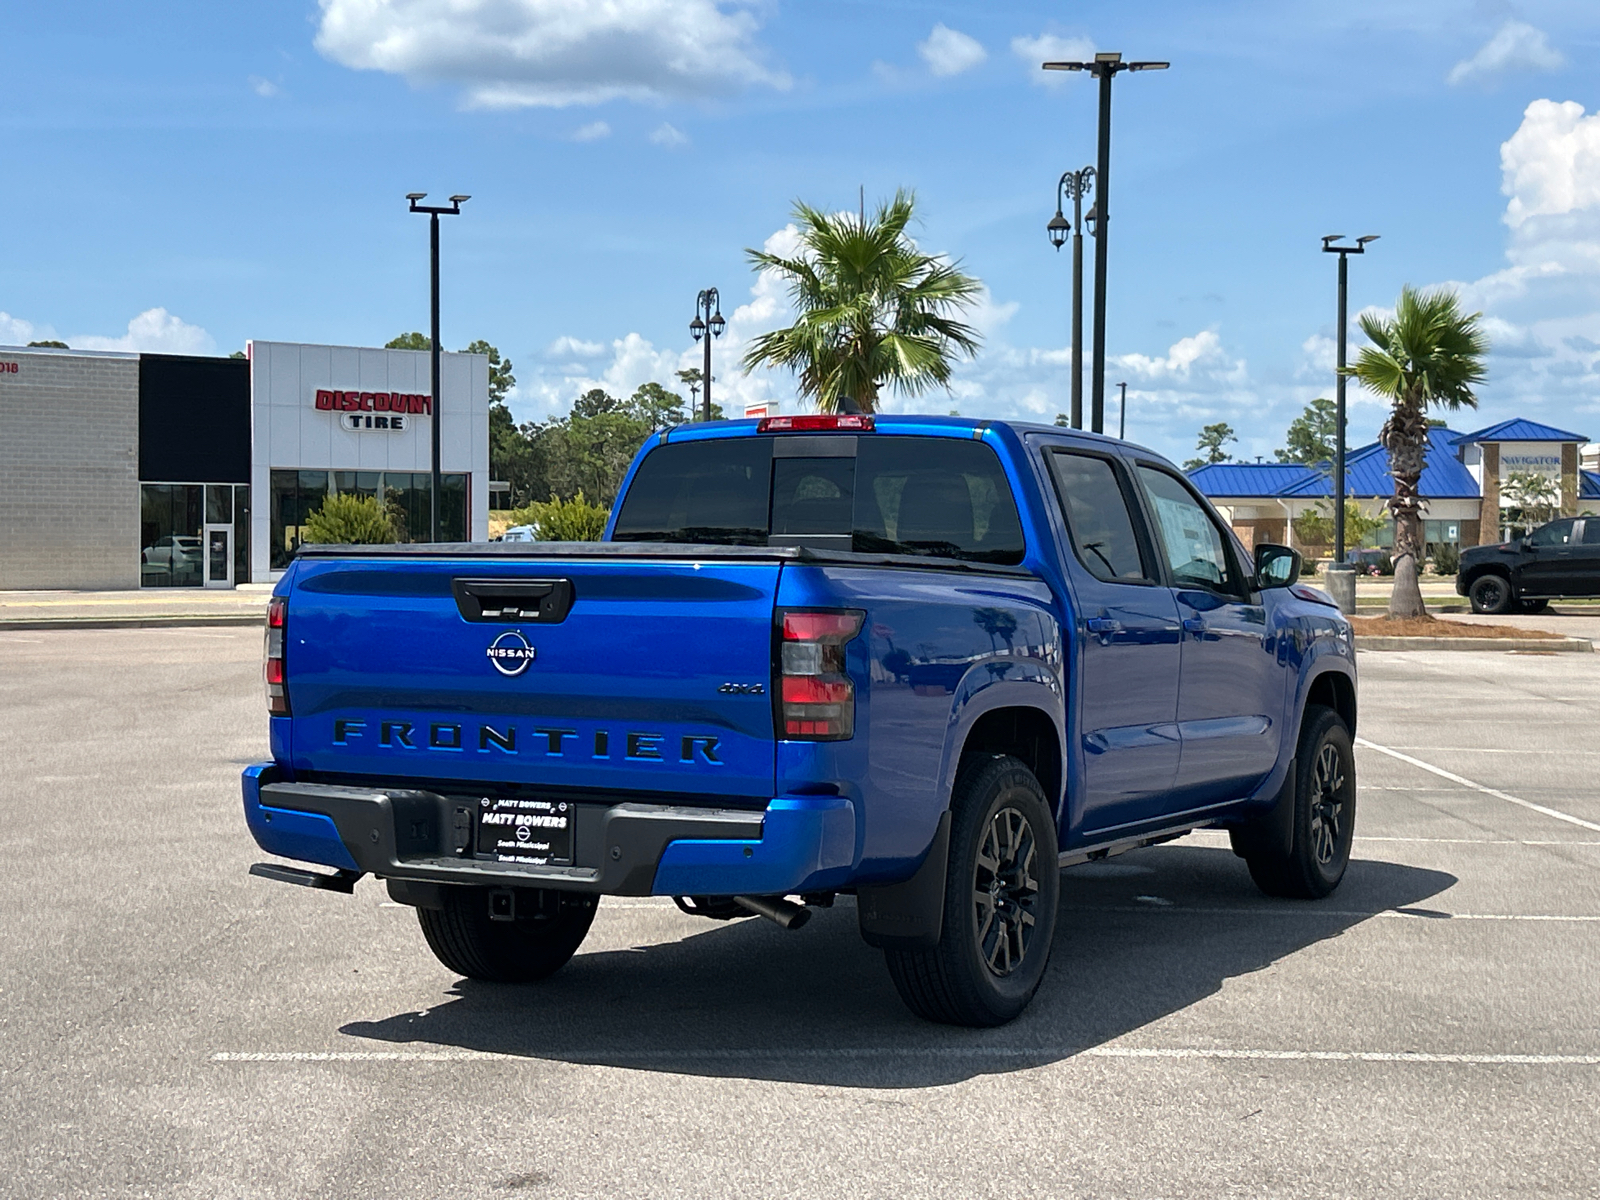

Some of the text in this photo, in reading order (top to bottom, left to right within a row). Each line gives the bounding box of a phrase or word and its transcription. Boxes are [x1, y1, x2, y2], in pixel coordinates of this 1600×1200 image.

[350, 416, 403, 429] TIRE
[1501, 456, 1561, 465] NAVIGATOR
[486, 647, 535, 659] NISSAN
[333, 717, 725, 766] FRONTIER
[519, 801, 551, 809] BOWERS
[482, 813, 567, 828] MATT BOWERS
